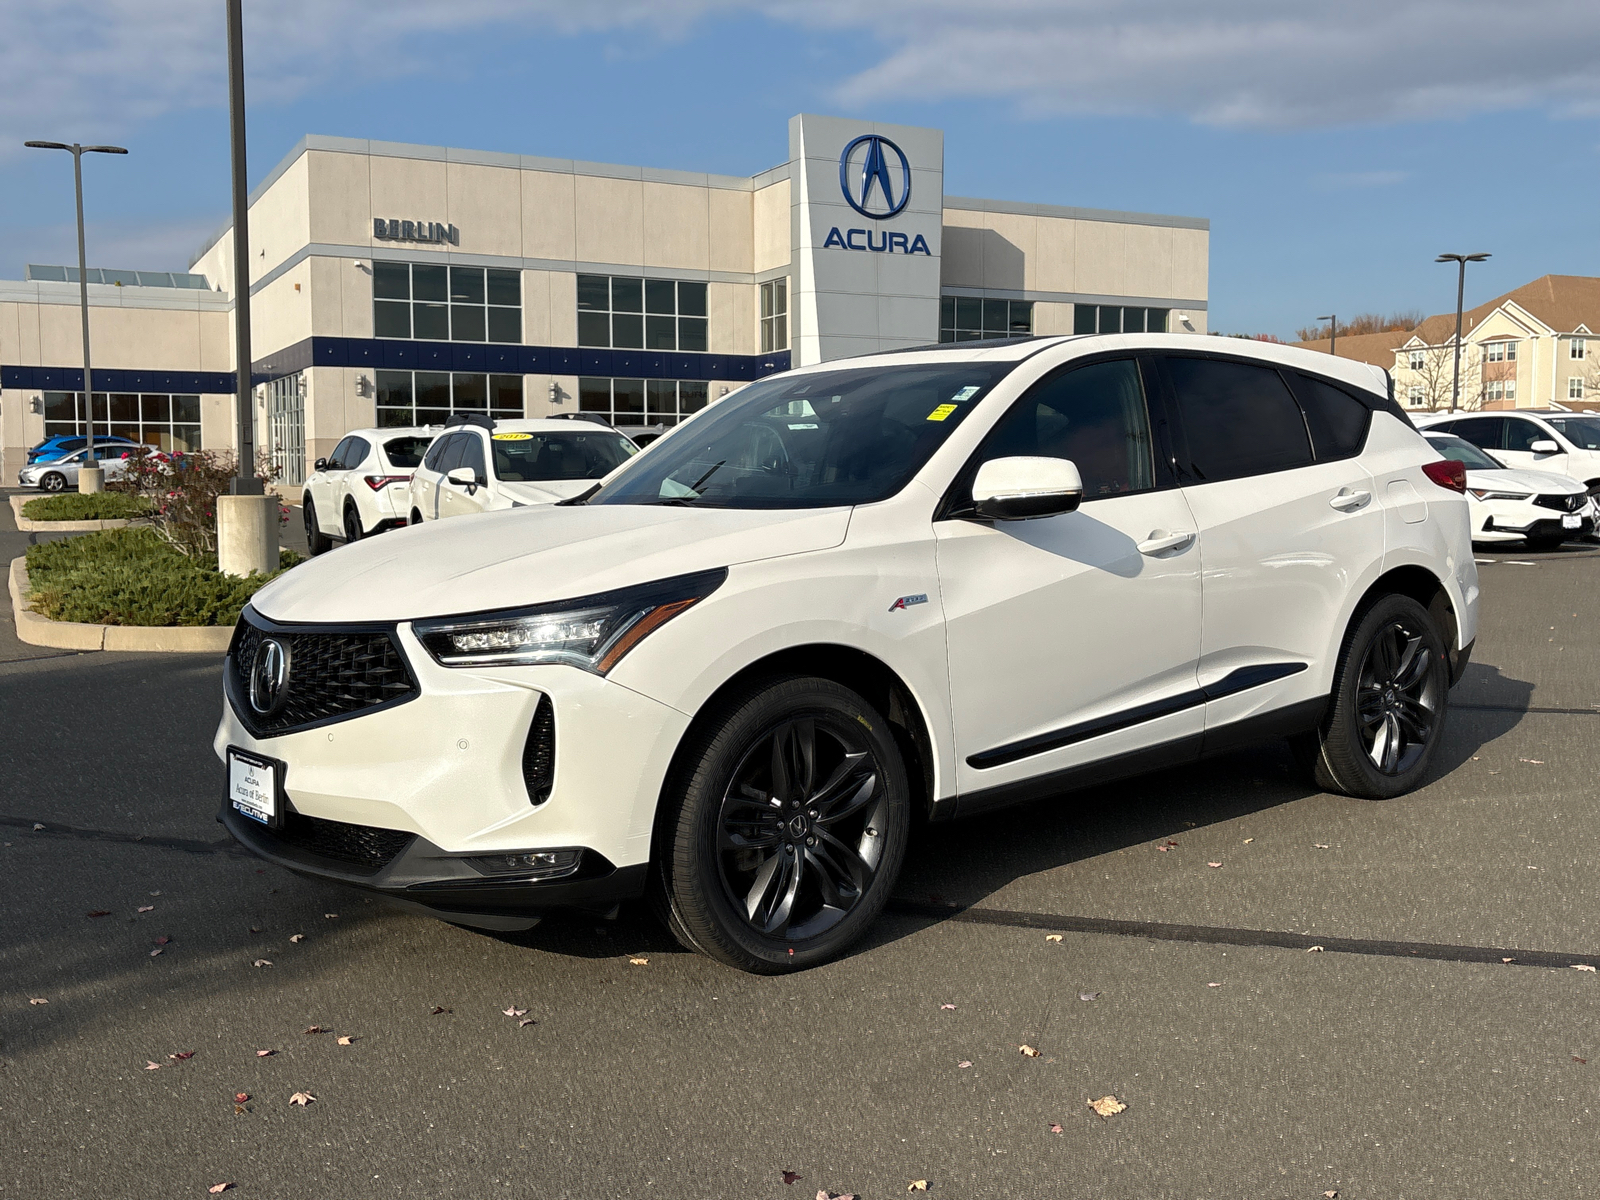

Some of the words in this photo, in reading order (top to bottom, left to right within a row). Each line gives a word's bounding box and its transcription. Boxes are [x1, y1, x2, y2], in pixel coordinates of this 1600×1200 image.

[373, 217, 453, 243] BERLIN
[823, 226, 931, 256] ACURA
[244, 776, 260, 787] ACURA
[235, 783, 248, 797] Acura
[249, 789, 254, 799] of
[255, 790, 269, 805] Berlin
